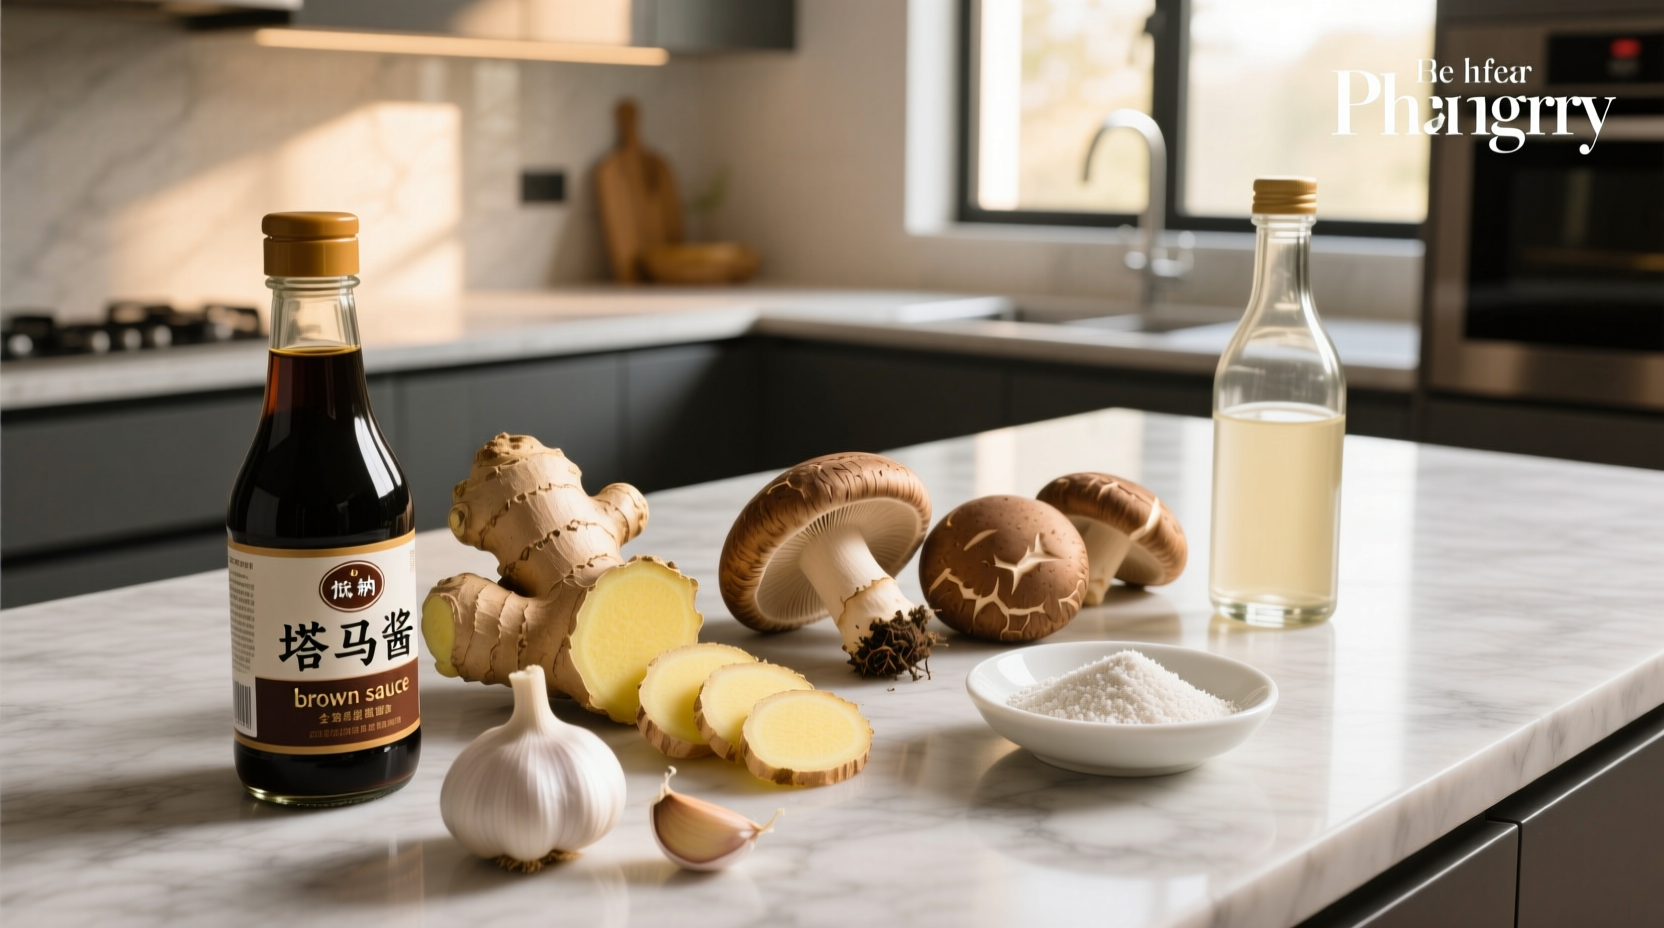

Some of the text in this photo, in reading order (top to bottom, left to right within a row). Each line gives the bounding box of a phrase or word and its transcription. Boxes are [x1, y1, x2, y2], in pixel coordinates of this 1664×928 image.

[278, 608, 414, 672] 塔马酱
[294, 676, 410, 709] brown sauce
